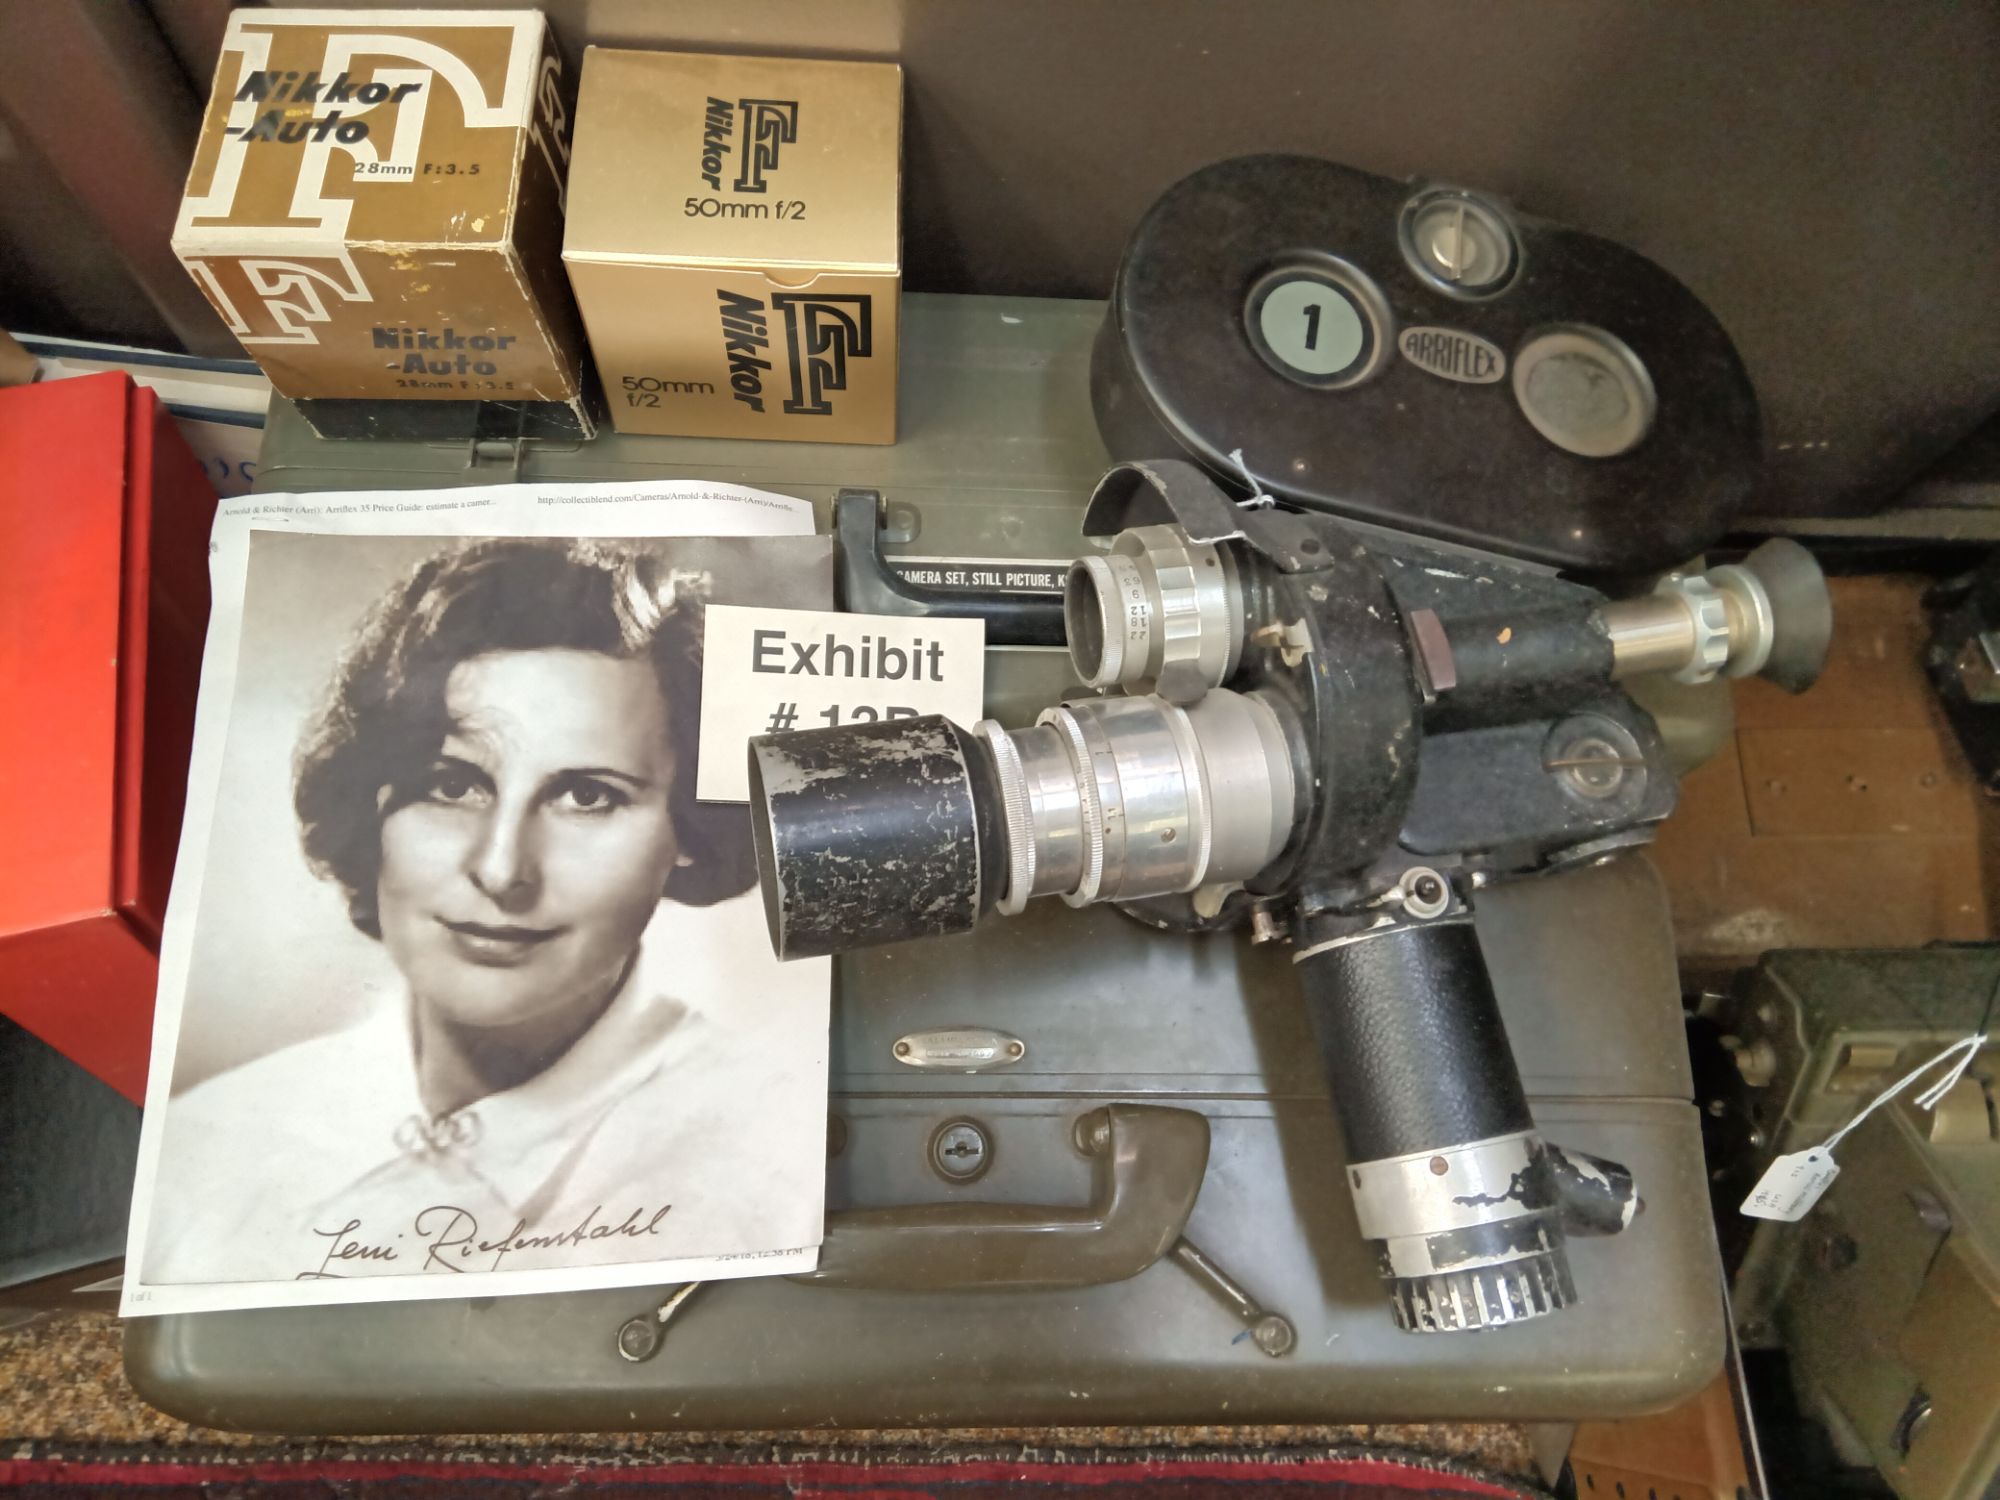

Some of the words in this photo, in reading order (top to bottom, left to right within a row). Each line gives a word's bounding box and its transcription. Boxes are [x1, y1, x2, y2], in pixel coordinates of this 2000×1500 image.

[234, 71, 423, 104] Nikkor
[702, 96, 734, 192] Nikkor
[353, 162, 413, 175] 28mm
[423, 163, 480, 175] F:3.5
[684, 197, 768, 219] 50mm
[775, 200, 806, 220] f/2
[1302, 303, 1322, 351] 1
[372, 327, 516, 351] Nikkor
[716, 288, 772, 413] Nikkor
[1405, 332, 1498, 379] ARRIFLEX
[396, 379, 453, 389] 28mm
[622, 376, 715, 394] 50mm
[627, 393, 661, 408] f/2
[263, 506, 293, 514] Richter
[373, 503, 394, 512] Price
[426, 501, 459, 511] estimate
[945, 571, 969, 587] SET,
[972, 572, 1002, 586] STILL
[1006, 573, 1055, 589] PICTURE,
[752, 629, 944, 682] Exhibit
